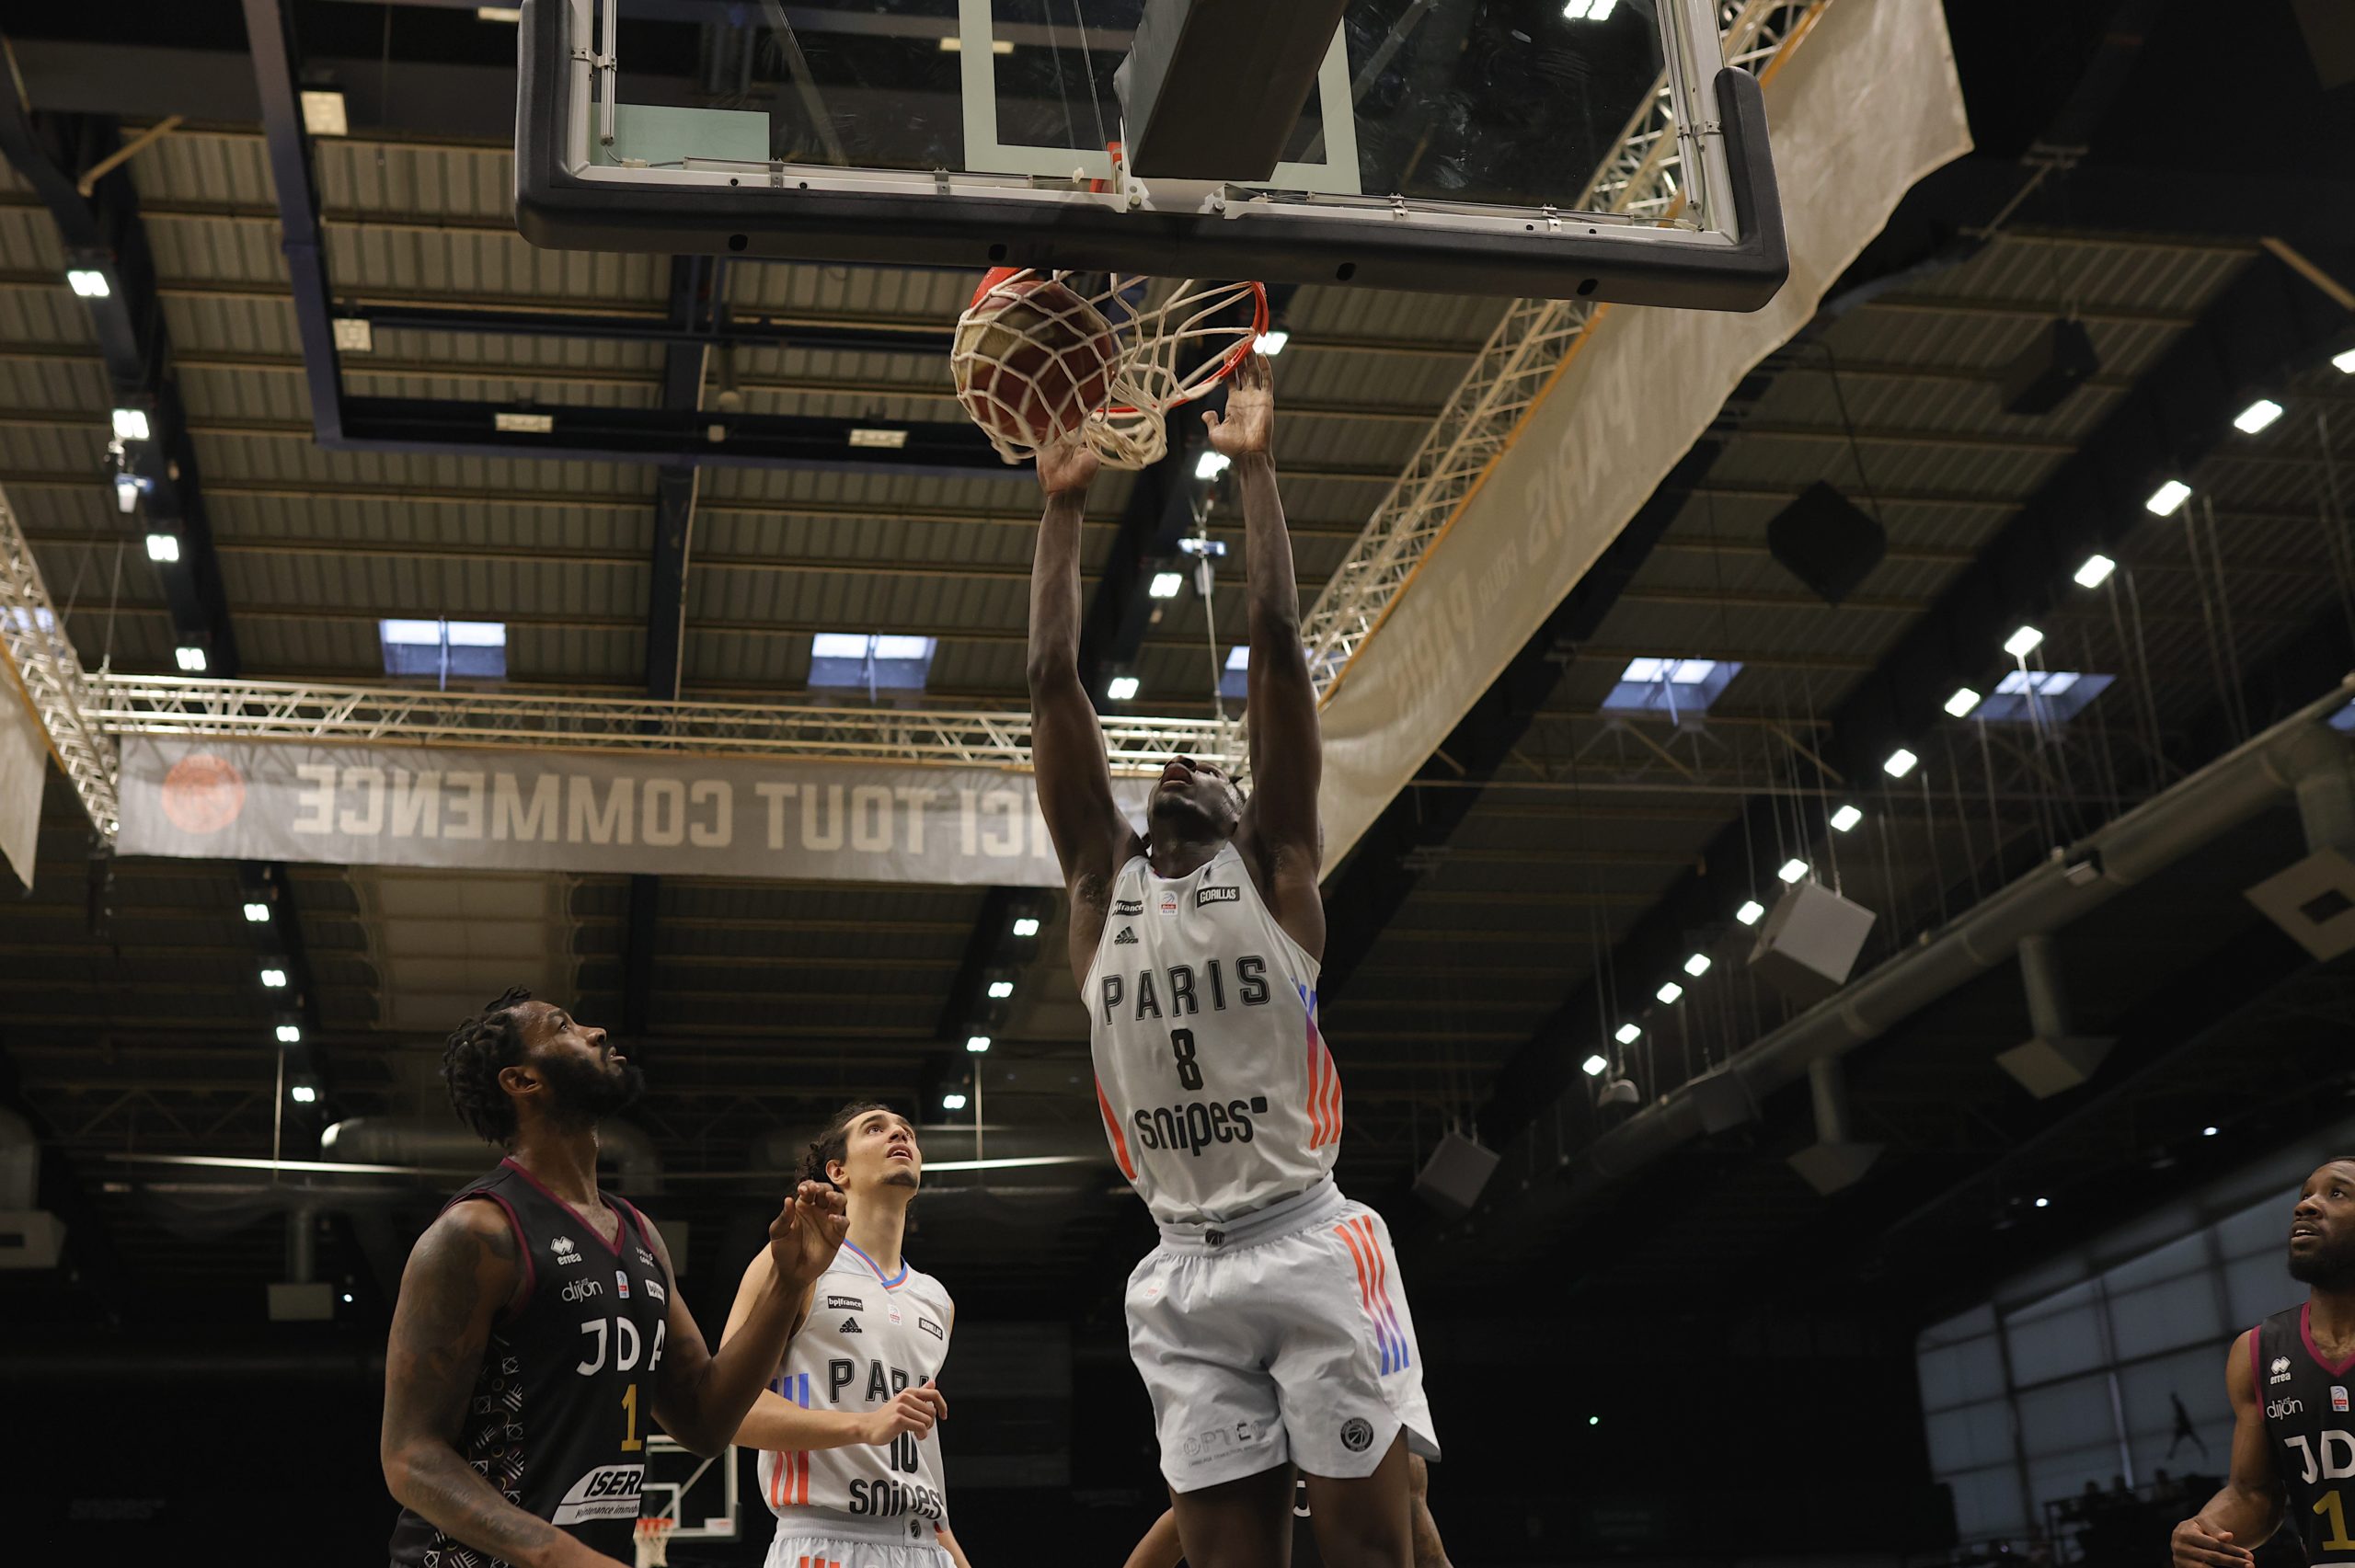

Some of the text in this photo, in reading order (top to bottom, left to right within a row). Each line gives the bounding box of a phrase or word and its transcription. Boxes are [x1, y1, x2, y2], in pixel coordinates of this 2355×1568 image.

[1199, 888, 1236, 904] GORILLAS
[1101, 955, 1270, 1025] PARIS
[1170, 1027, 1203, 1091] 8
[1134, 1099, 1254, 1157] snipes
[561, 1281, 603, 1302] dijon
[829, 1358, 930, 1403] PAR
[2267, 1399, 2303, 1420] dijon
[621, 1383, 642, 1451] 1
[2312, 1490, 2355, 1551] 1
